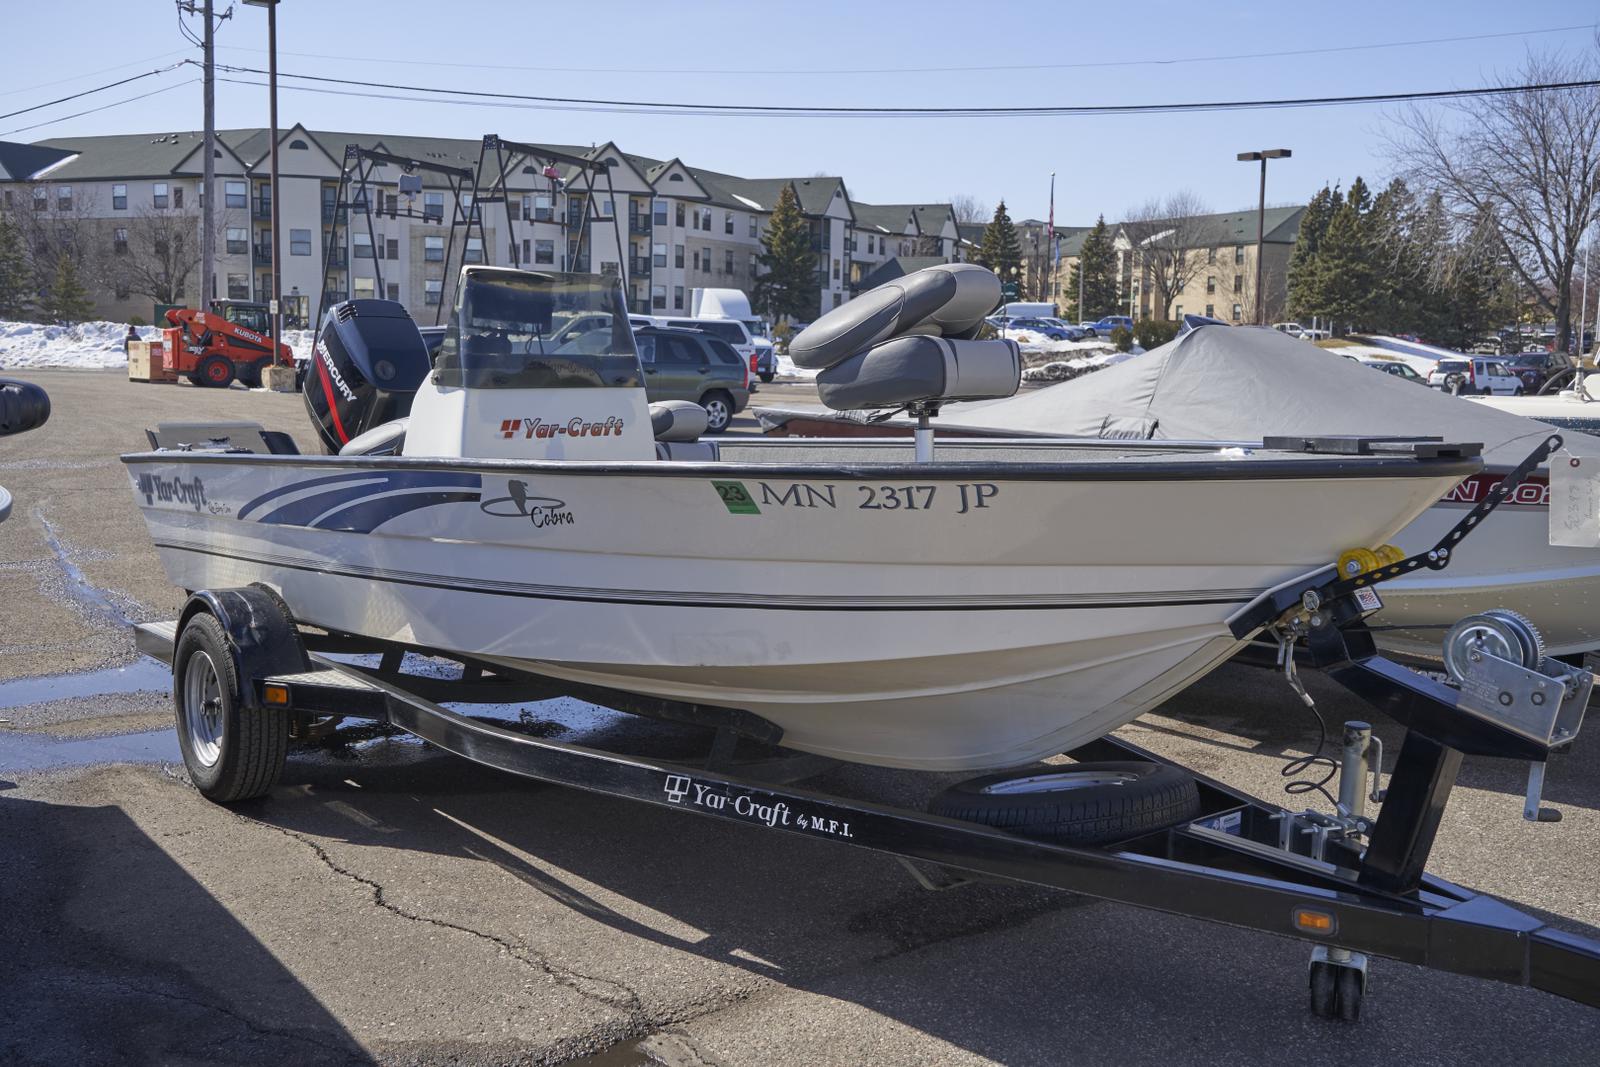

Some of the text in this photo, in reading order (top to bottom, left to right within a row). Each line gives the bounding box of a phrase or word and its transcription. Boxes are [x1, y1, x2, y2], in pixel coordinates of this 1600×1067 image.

[234, 327, 262, 343] KUBOTA
[317, 339, 357, 402] MERCURY
[524, 416, 624, 439] Yar-Craft
[152, 475, 207, 512] Yar-Craft
[715, 485, 746, 501] 23
[758, 481, 999, 514] MN 2317 JP
[531, 506, 574, 528] Cobra
[693, 783, 853, 838] Yar-Craft by M.F.I.
